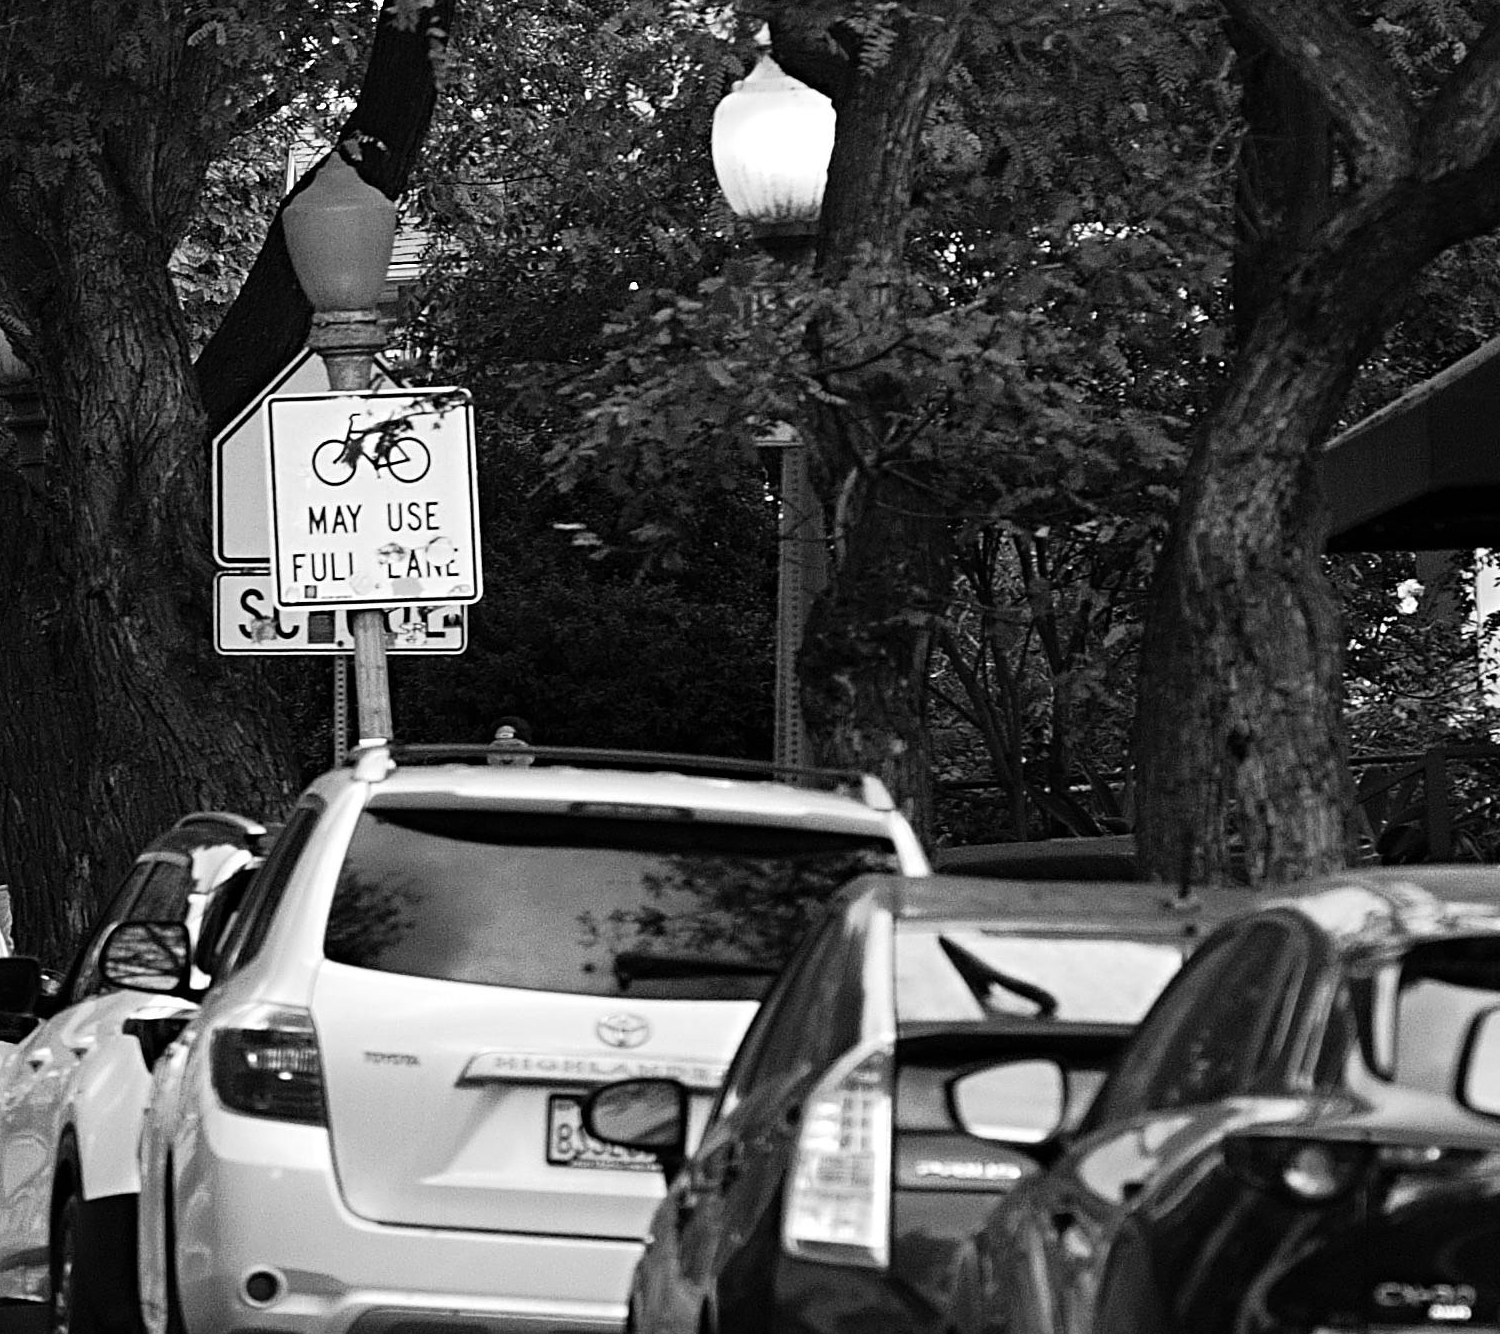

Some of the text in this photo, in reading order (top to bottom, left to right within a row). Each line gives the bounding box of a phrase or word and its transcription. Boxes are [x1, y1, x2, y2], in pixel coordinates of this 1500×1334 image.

[309, 501, 440, 534] MAY USE
[238, 588, 447, 639] SCL
[494, 1056, 720, 1081] HIGHLANDE
